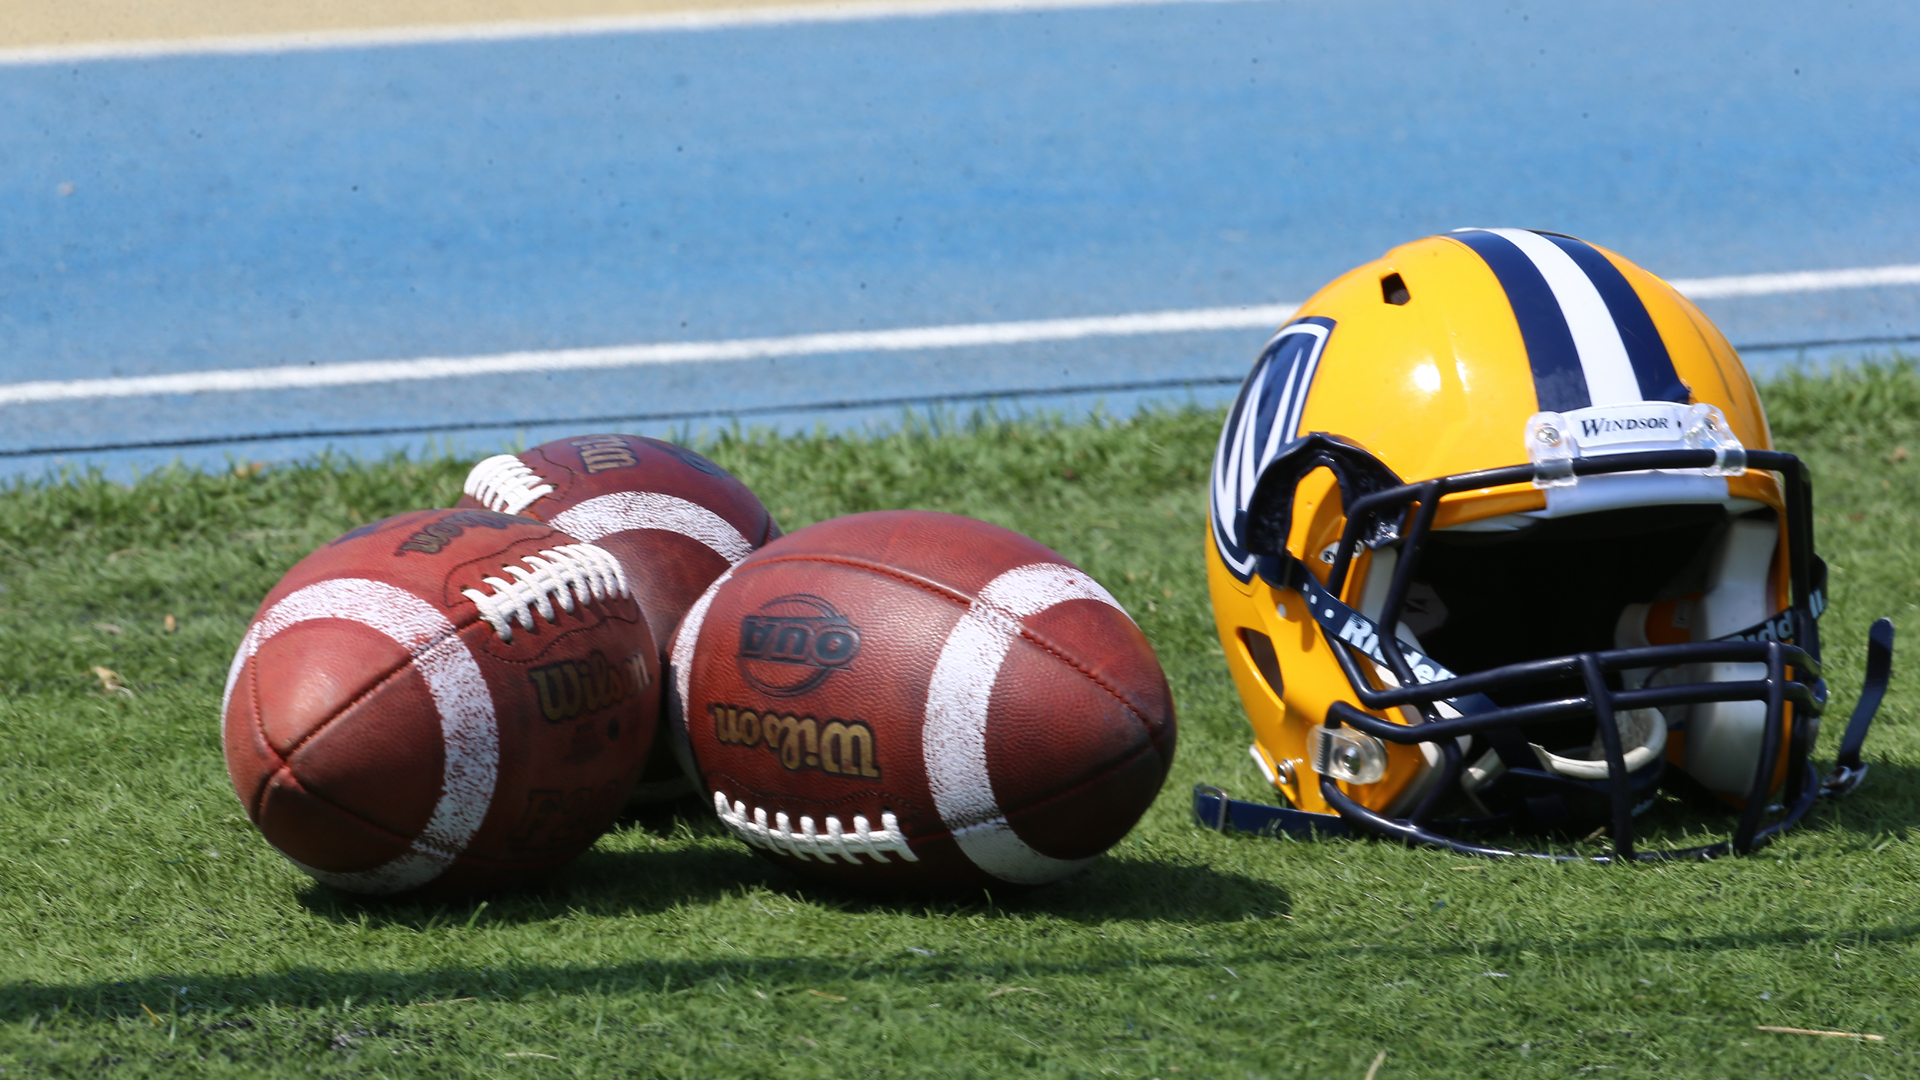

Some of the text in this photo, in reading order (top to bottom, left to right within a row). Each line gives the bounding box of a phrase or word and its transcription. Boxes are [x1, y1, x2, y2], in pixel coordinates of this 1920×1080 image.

[1580, 417, 1669, 438] WINDSOR
[739, 618, 860, 669] OUA
[528, 648, 652, 722] Wilson
[708, 703, 882, 779] Wilson
